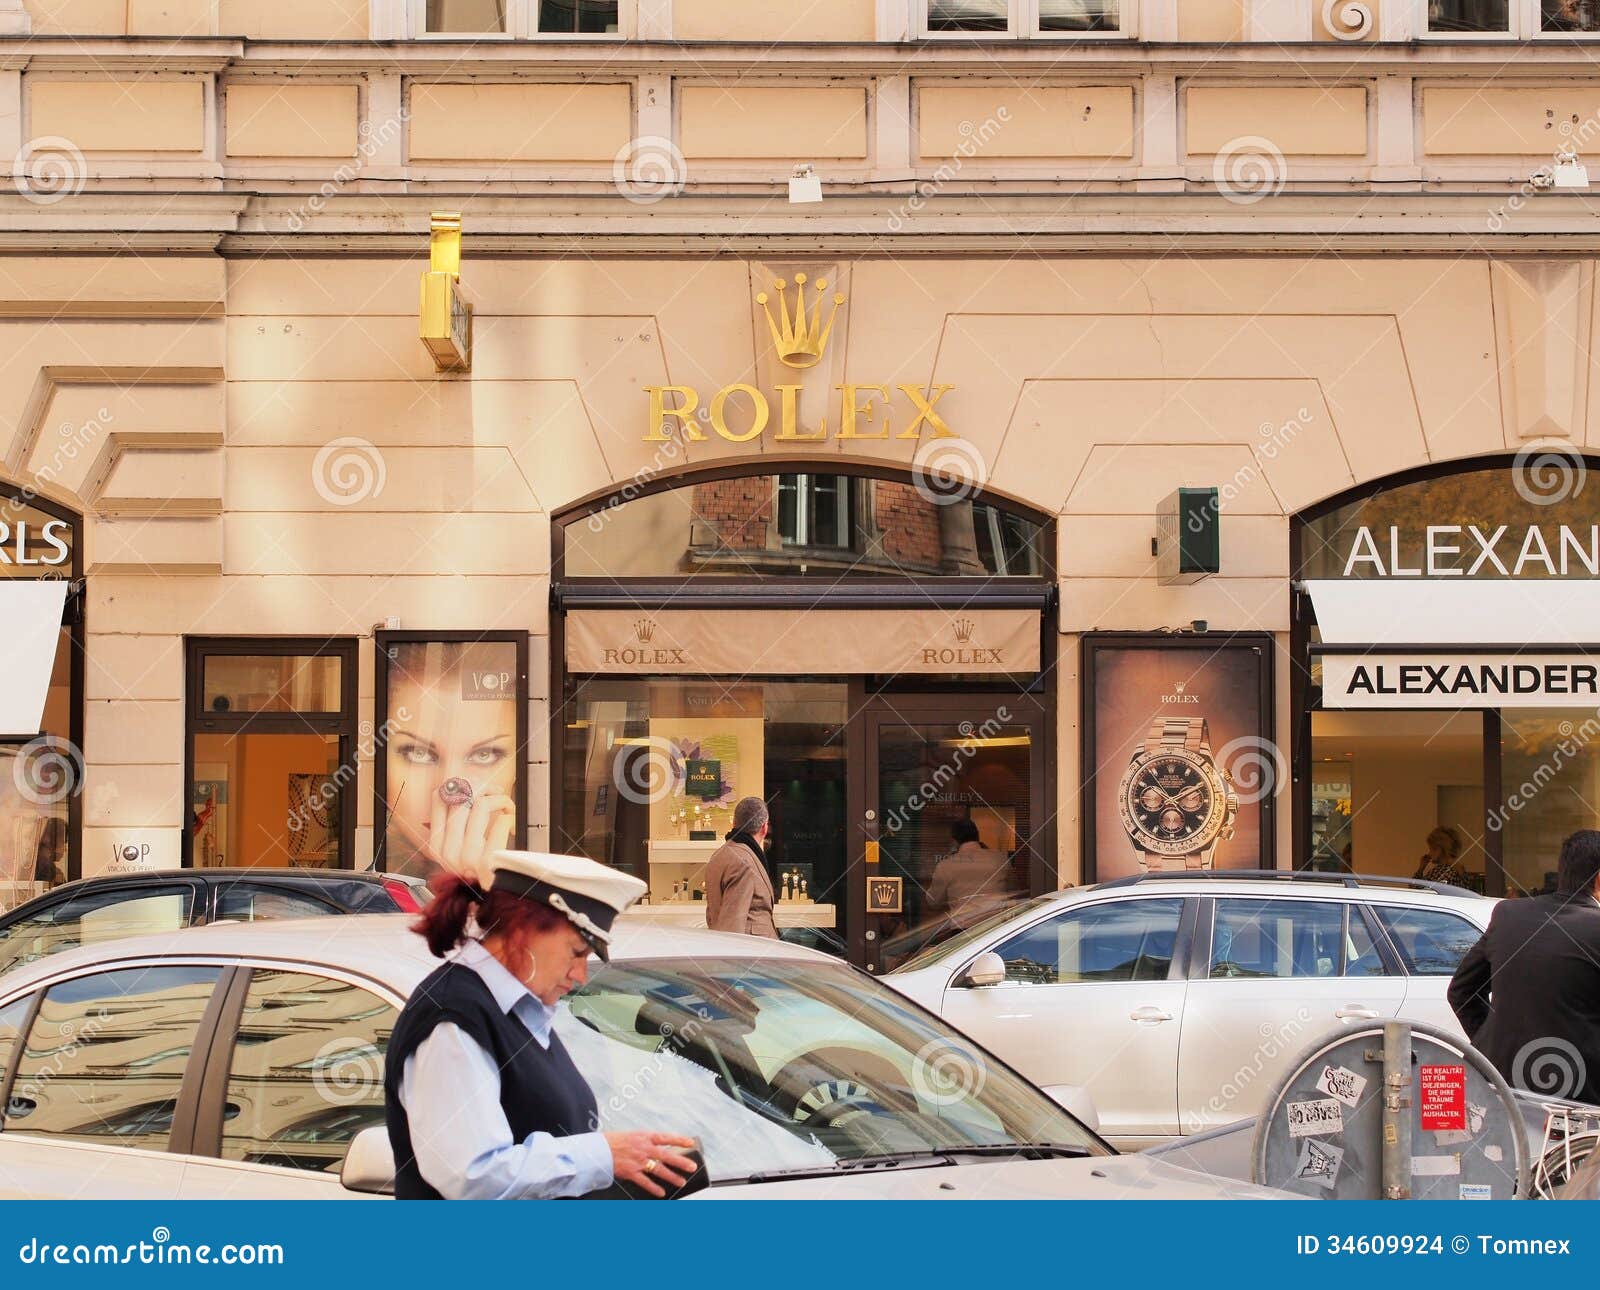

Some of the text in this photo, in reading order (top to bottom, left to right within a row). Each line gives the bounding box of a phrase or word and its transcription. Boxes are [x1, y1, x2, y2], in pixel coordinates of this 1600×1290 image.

[641, 383, 960, 442] ROLEX
[1342, 525, 1599, 577] ALEXAN
[603, 648, 687, 665] ROLEX
[921, 648, 1004, 664] ROLEX
[1346, 665, 1599, 694] ALEXANDER
[1161, 695, 1200, 703] ROLEX
[1434, 1066, 1463, 1074] REALITÄT
[1428, 1095, 1455, 1103] TRÄUME
